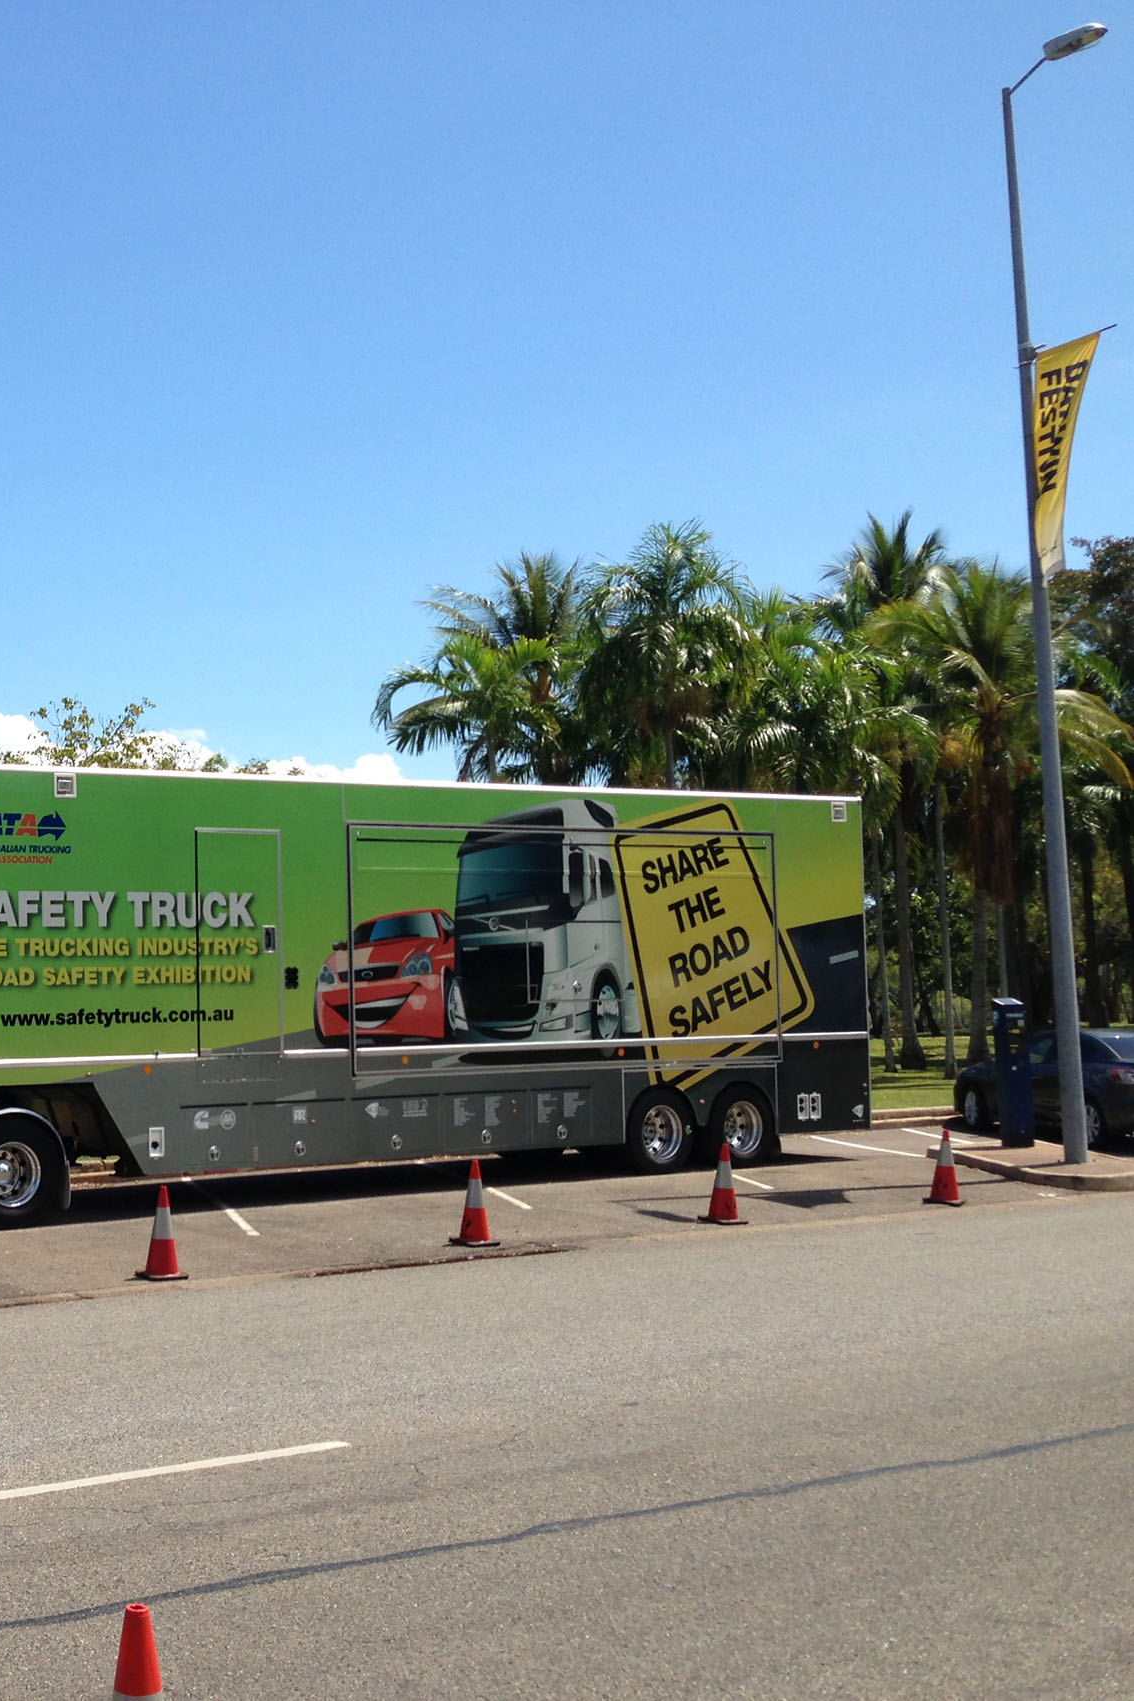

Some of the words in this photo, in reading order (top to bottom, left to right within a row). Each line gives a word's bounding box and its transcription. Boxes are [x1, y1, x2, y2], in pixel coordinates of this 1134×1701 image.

[29, 845, 71, 855] TRUCKING
[642, 837, 730, 894] SHARE
[127, 891, 255, 928] TRUCK
[668, 886, 726, 933] THE
[15, 938, 130, 957] TRUCKING
[137, 938, 259, 957] INDUSTRY'S
[668, 926, 750, 988] ROAD
[42, 966, 126, 986] SAFETY
[132, 965, 252, 985] EXHIBITION
[1, 1007, 234, 1028] www.safetytruck.com.au
[669, 960, 773, 1038] SAFELY
